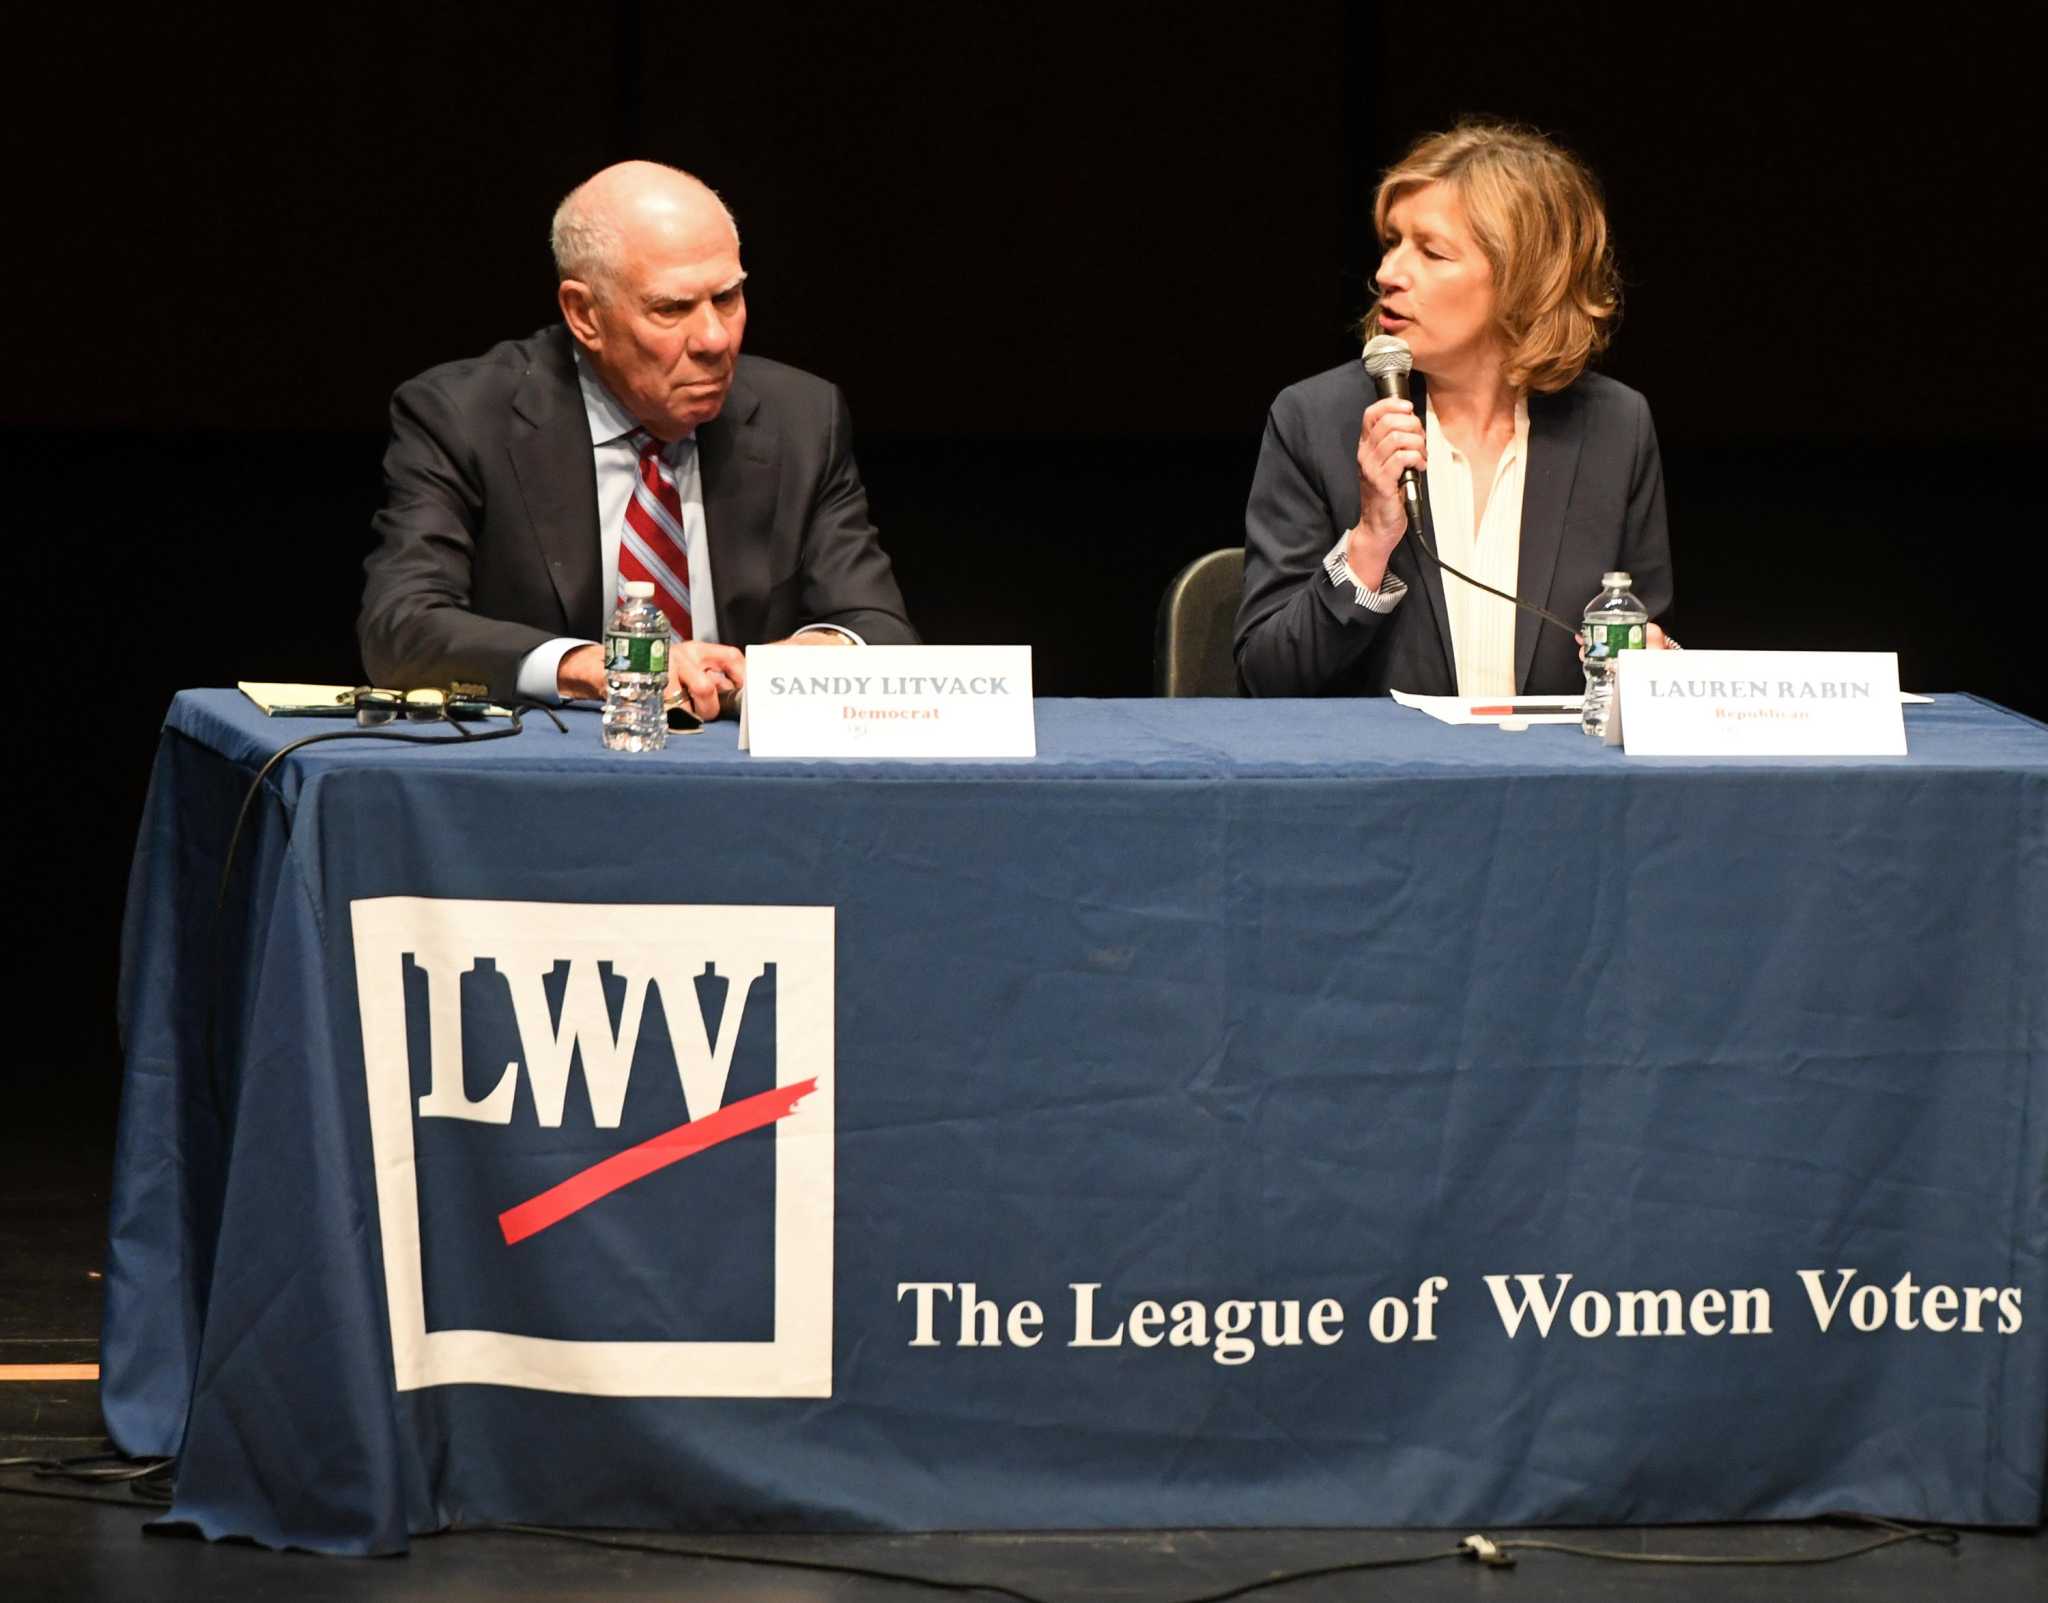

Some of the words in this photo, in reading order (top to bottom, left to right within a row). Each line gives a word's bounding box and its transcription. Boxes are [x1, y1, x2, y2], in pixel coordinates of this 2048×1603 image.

[769, 676, 873, 696] SANDY
[882, 676, 1010, 696] LITVACK
[1648, 679, 1769, 698] LAUREN
[1778, 681, 1871, 699] RABIN
[842, 705, 941, 720] Democrat
[418, 956, 775, 1129] LWV
[896, 1281, 1045, 1348] The
[1066, 1282, 1345, 1366] League
[1368, 1275, 1449, 1343] of
[1482, 1273, 1774, 1340] Women
[1796, 1268, 2024, 1334] Voters
